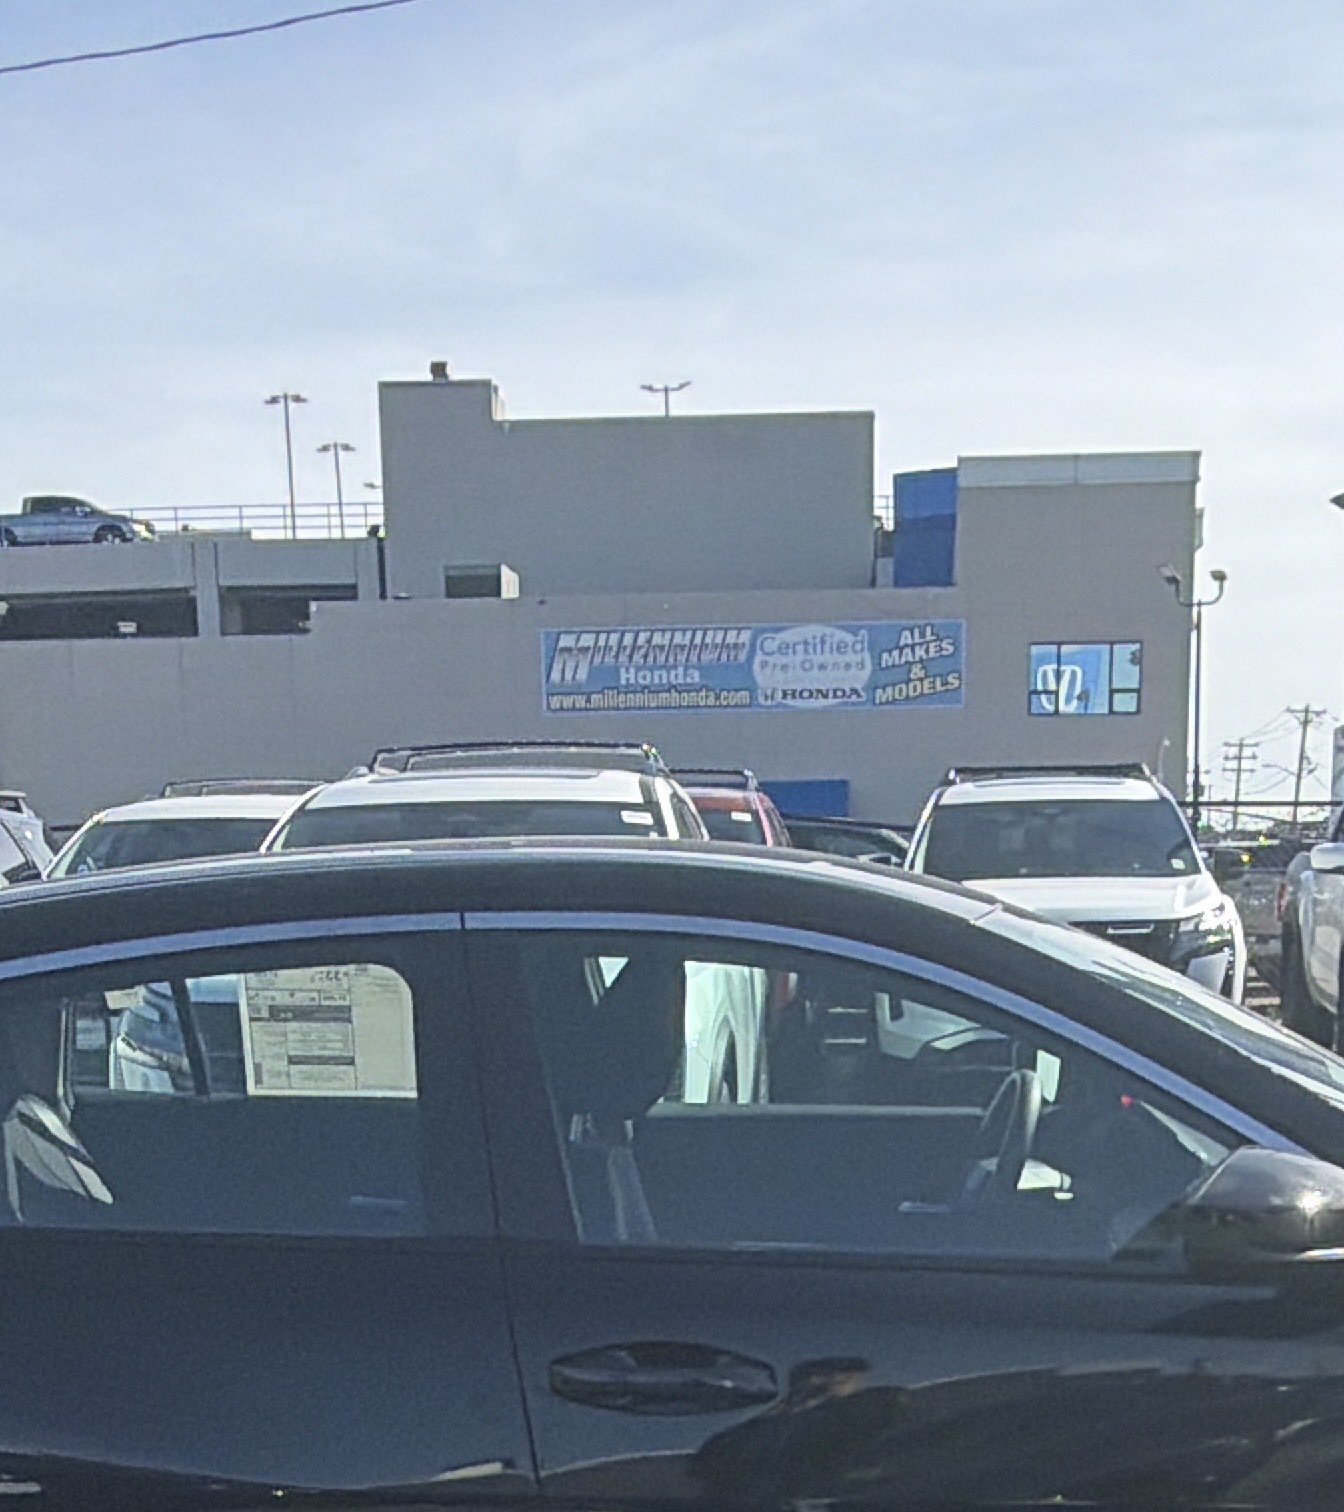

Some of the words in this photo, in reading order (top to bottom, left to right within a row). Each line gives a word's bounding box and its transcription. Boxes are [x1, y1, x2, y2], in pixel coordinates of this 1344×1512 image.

[759, 629, 867, 657] Certified
[899, 624, 937, 647] ALL
[548, 629, 752, 684] MILLENNIUM
[880, 638, 955, 668] MAKES
[619, 666, 701, 685] Honda
[910, 662, 926, 680] &
[548, 688, 750, 710] www.millenniumhonda.com
[781, 687, 864, 700] HONDA
[874, 672, 961, 705] MODELS
